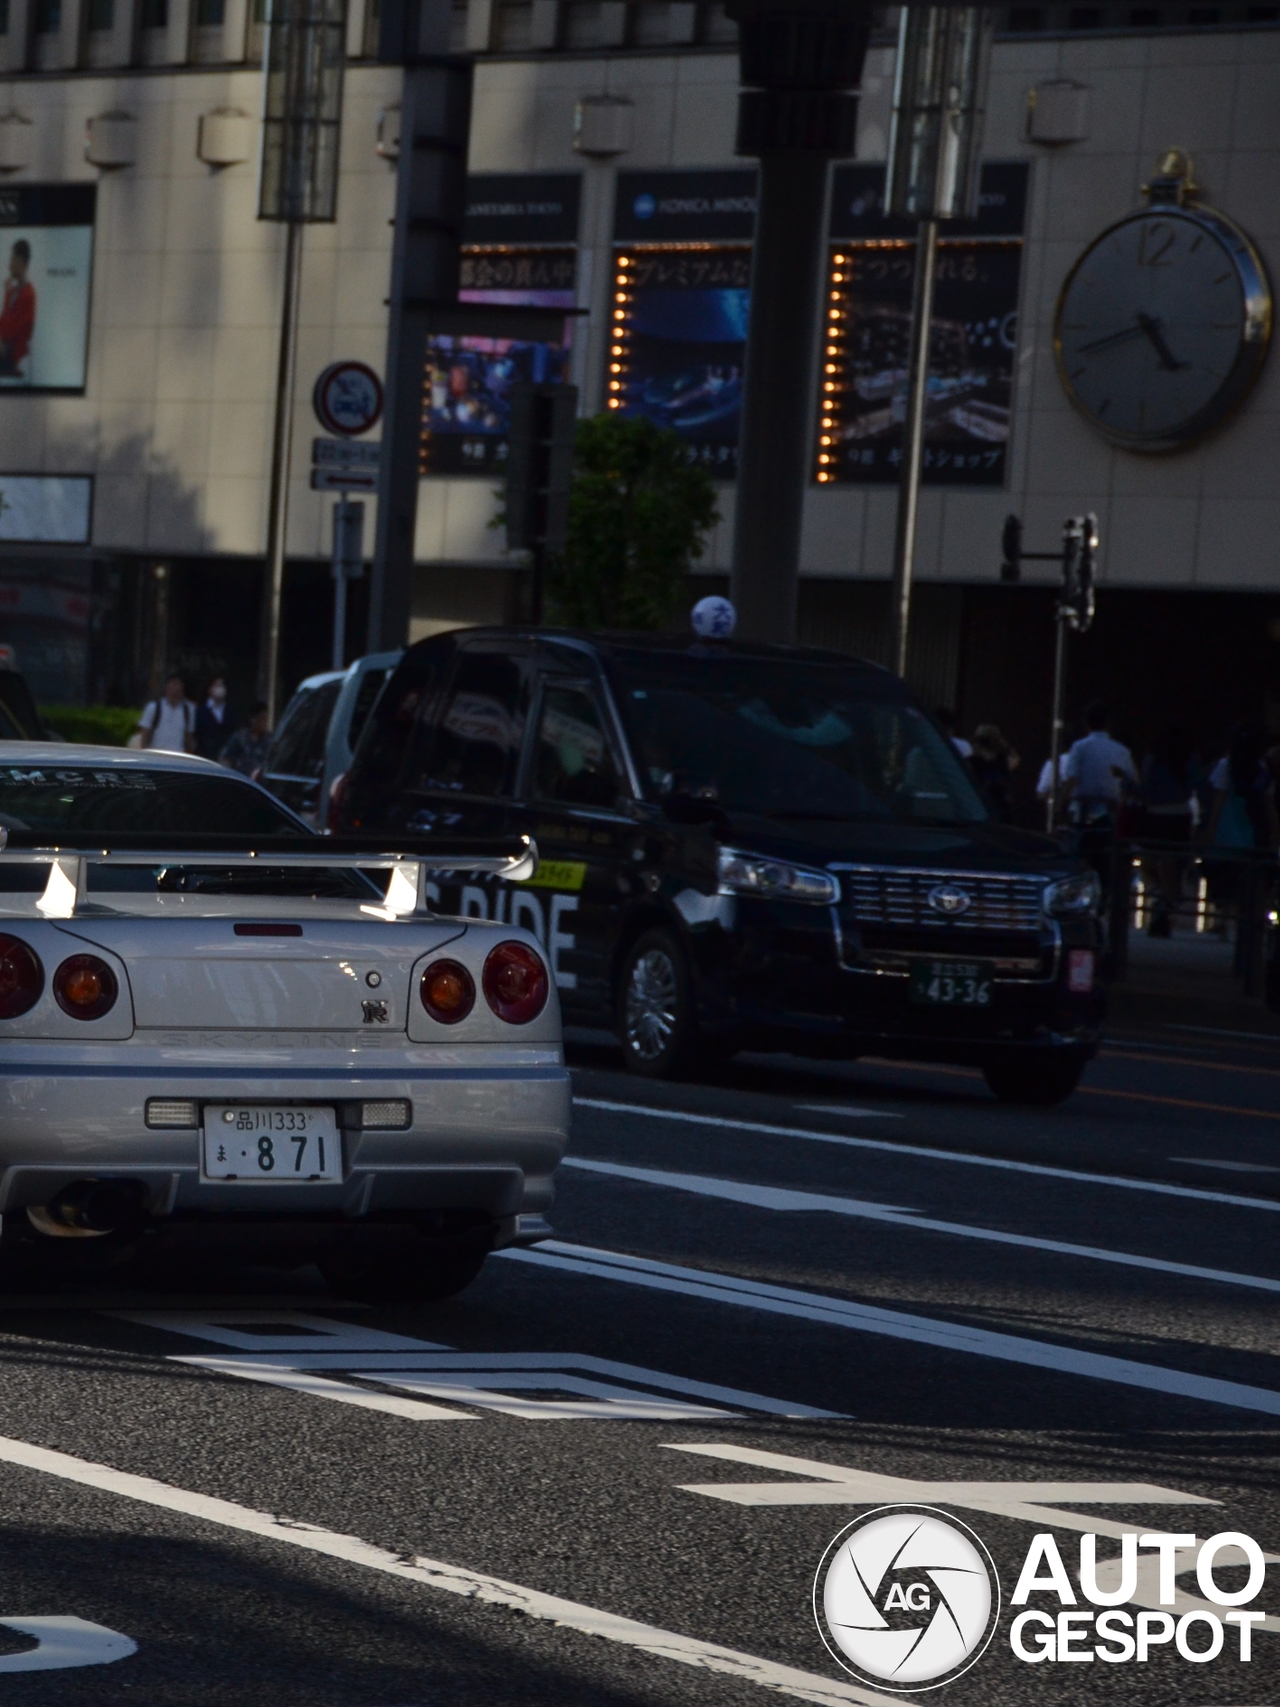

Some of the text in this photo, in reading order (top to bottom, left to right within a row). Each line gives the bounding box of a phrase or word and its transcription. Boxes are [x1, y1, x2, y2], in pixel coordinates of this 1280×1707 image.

[659, 198, 711, 214] KONICA
[1137, 221, 1176, 267] 12
[887, 446, 1002, 470] ギトショップ
[927, 977, 991, 1004] 43-36
[161, 1032, 382, 1048] SKYLINE
